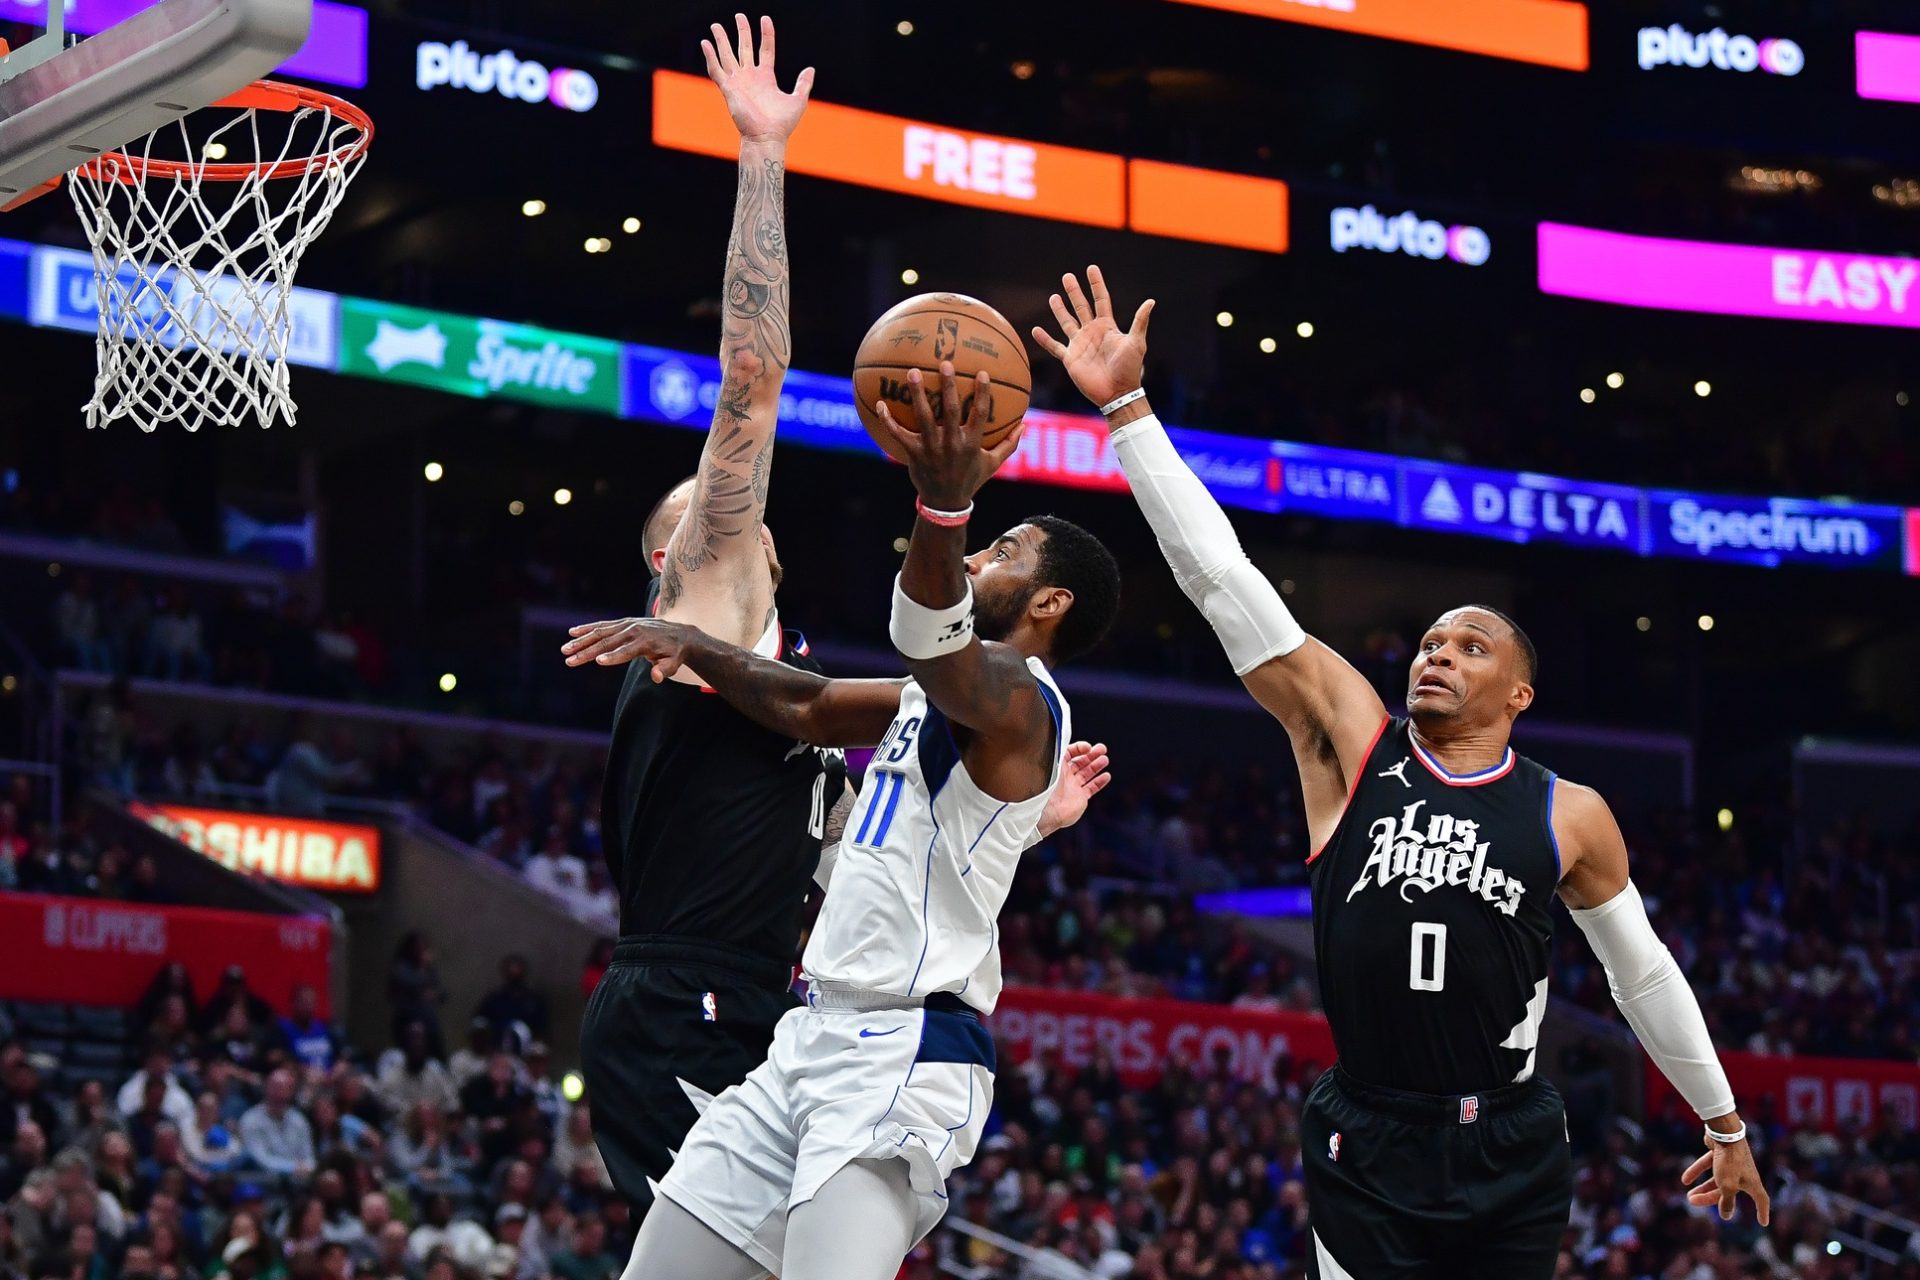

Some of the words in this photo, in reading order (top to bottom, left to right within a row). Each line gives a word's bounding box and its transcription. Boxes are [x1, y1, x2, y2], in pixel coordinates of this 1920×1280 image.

[416, 40, 550, 104] pluto
[1637, 22, 1758, 73] pluto
[903, 125, 1037, 200] FREE
[1330, 203, 1447, 260] pluto
[1772, 254, 1916, 314] EASY
[468, 331, 596, 395] Sprite
[1285, 462, 1392, 506] ULTRA
[1472, 482, 1627, 540] DELTA
[1669, 499, 1870, 556] Spectrum
[852, 769, 906, 848] 11
[1394, 799, 1480, 852] Los
[1346, 816, 1526, 917] Angeles
[1409, 921, 1447, 991] 0
